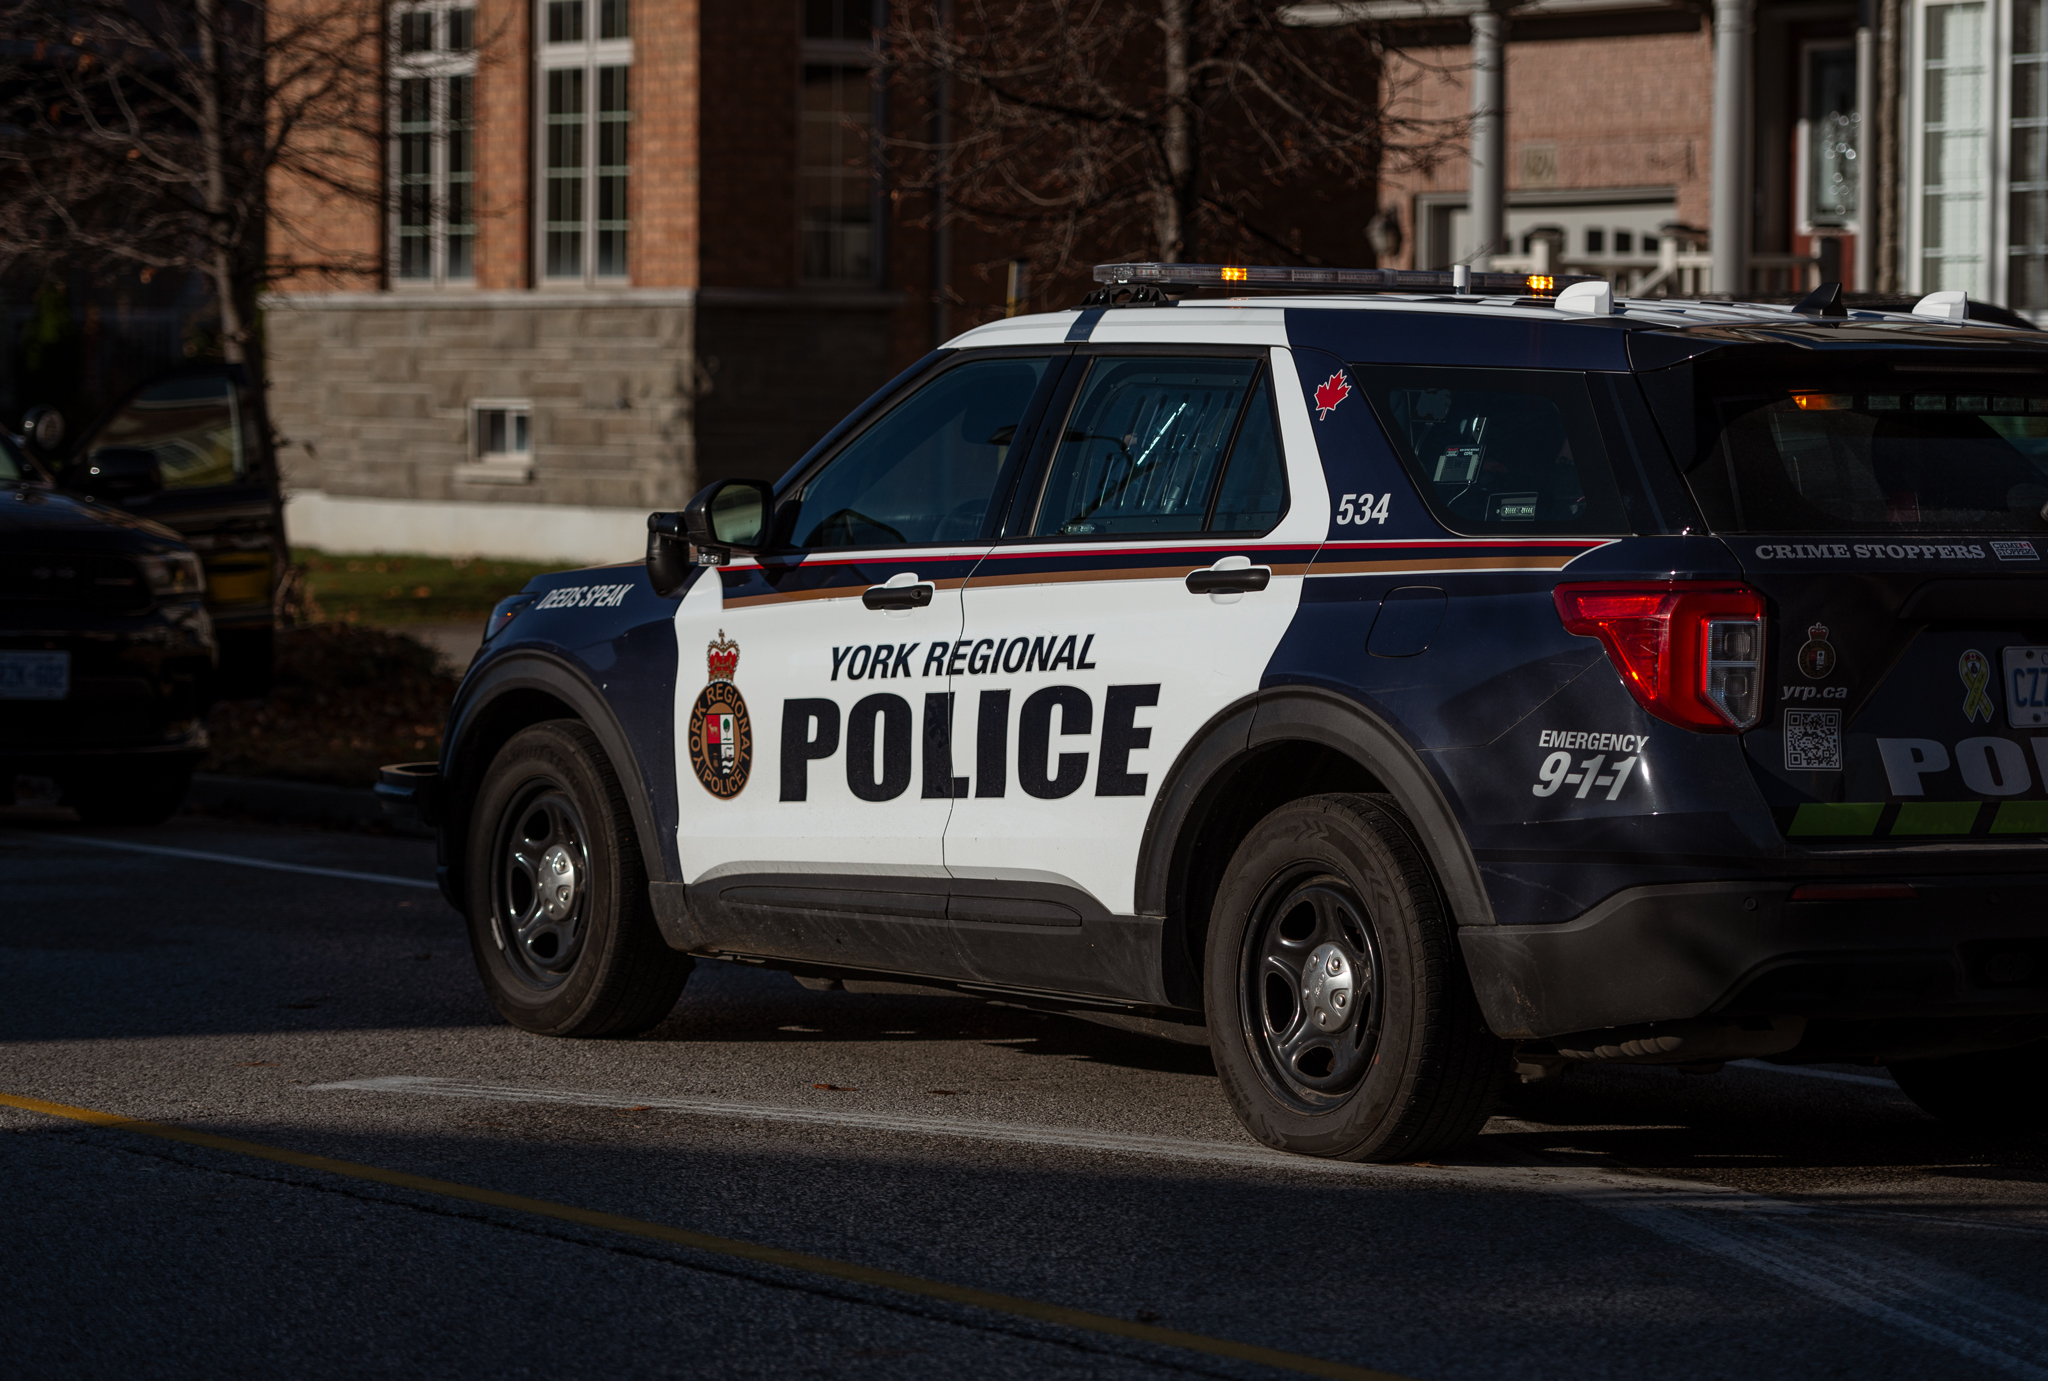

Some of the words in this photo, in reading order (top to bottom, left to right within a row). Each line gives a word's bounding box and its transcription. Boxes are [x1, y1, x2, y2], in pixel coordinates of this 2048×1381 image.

[1336, 493, 1391, 525] 534
[1755, 544, 1850, 560] CRIME
[1856, 544, 1986, 559] STOPPERS
[535, 586, 590, 610] DEEDS
[578, 583, 635, 607] SPEAK
[830, 642, 920, 682] YORK
[922, 633, 1097, 677] REGIONAL
[1781, 685, 1848, 701] yrp.ca
[690, 701, 707, 770] YORK
[706, 684, 751, 763] REGIONAL
[1539, 730, 1649, 753] EMERGENCY
[779, 682, 1162, 803] POLICE
[703, 771, 745, 795] POLICE
[1532, 751, 1638, 800] 9-1-1
